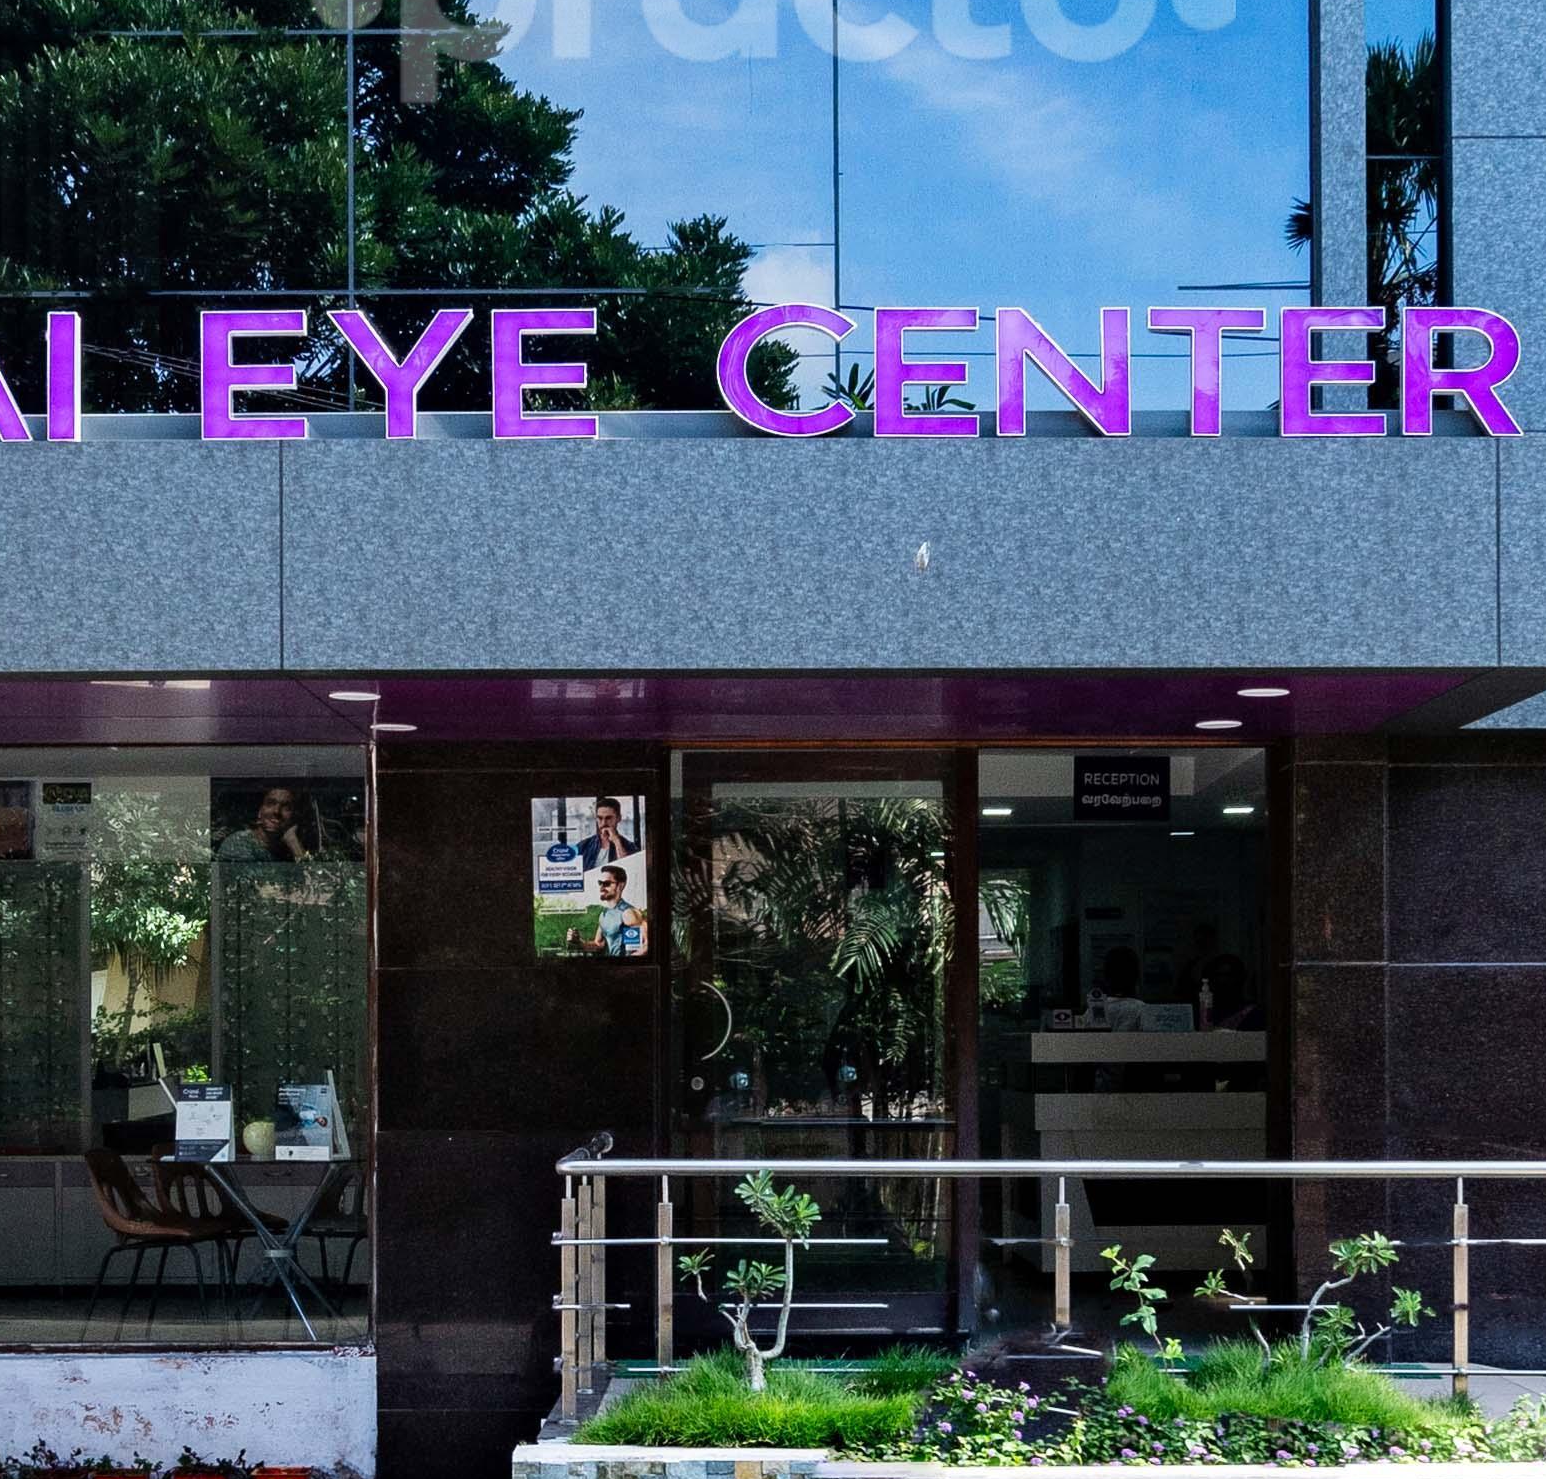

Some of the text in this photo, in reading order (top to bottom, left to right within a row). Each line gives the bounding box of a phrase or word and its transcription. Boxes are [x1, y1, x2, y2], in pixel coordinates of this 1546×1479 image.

[200, 308, 600, 439] EYE
[715, 303, 1524, 438] CENTER
[1084, 773, 1159, 785] RECEPTION
[1082, 793, 1162, 808] வரவேற்பறை
